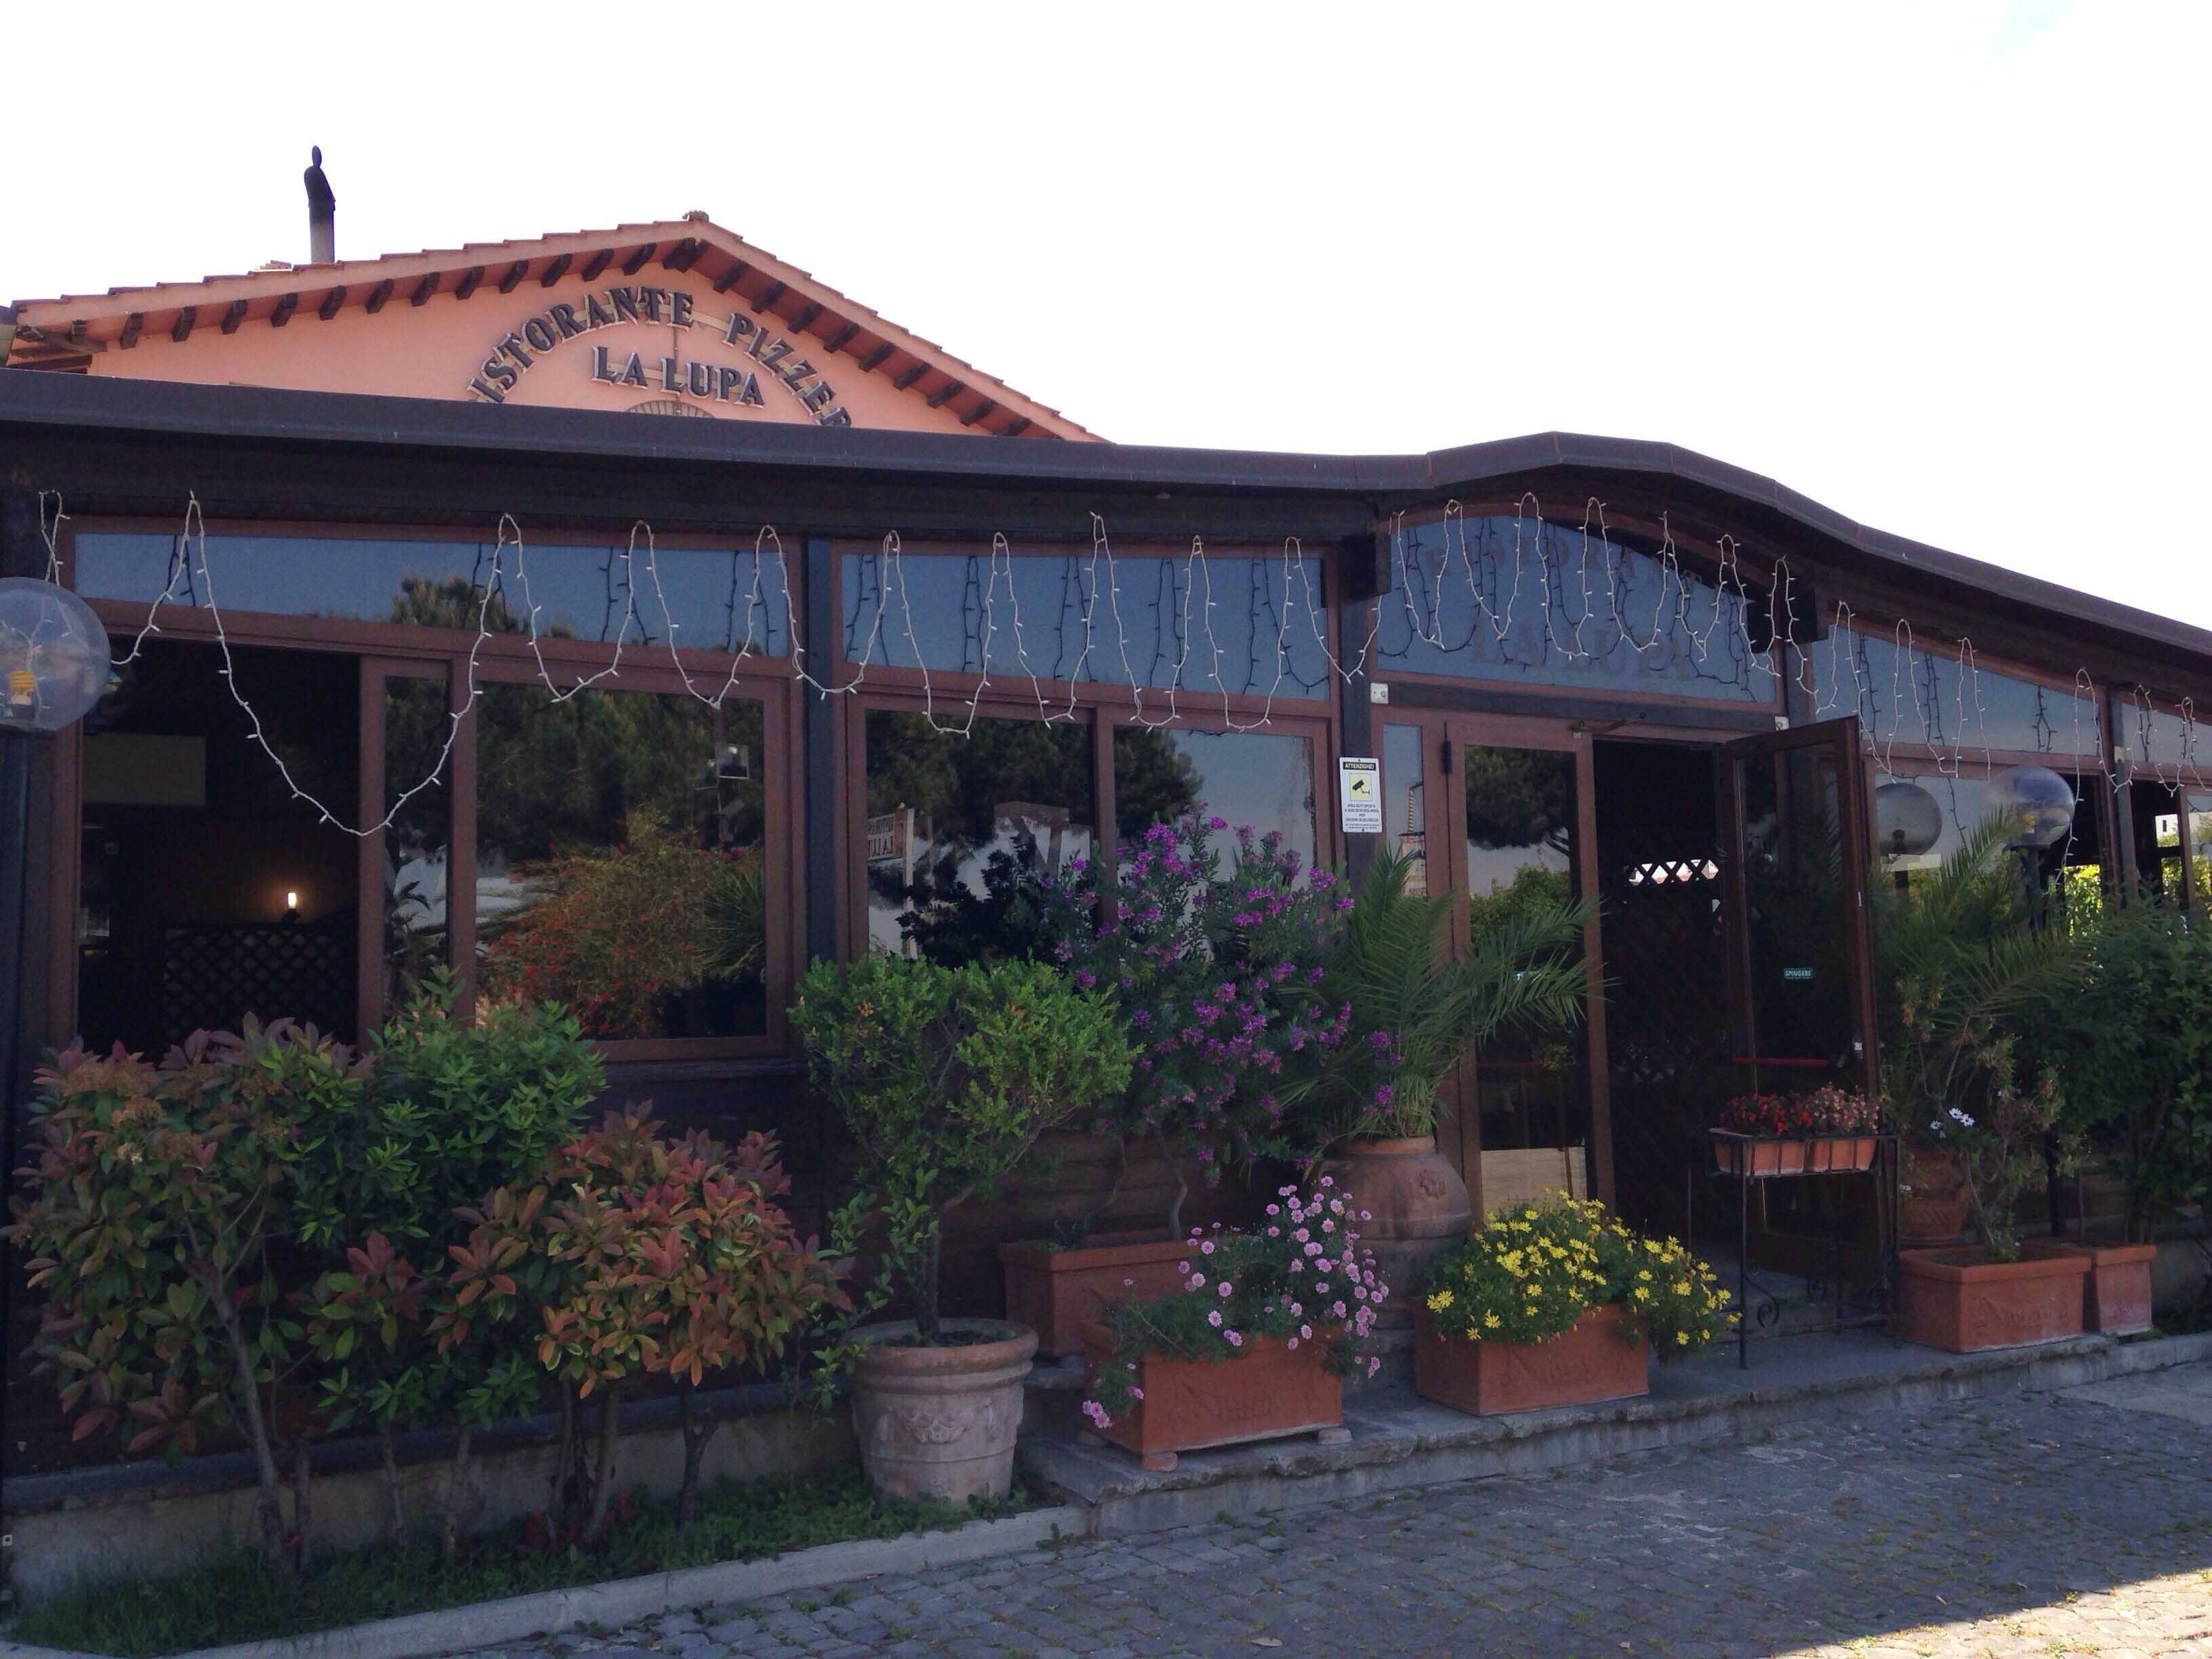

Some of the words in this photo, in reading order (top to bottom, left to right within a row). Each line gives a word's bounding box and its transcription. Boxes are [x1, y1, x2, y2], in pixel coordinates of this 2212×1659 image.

[466, 287, 694, 403] ISTORANTE
[590, 346, 648, 390] LA
[659, 357, 765, 409] LUPA
